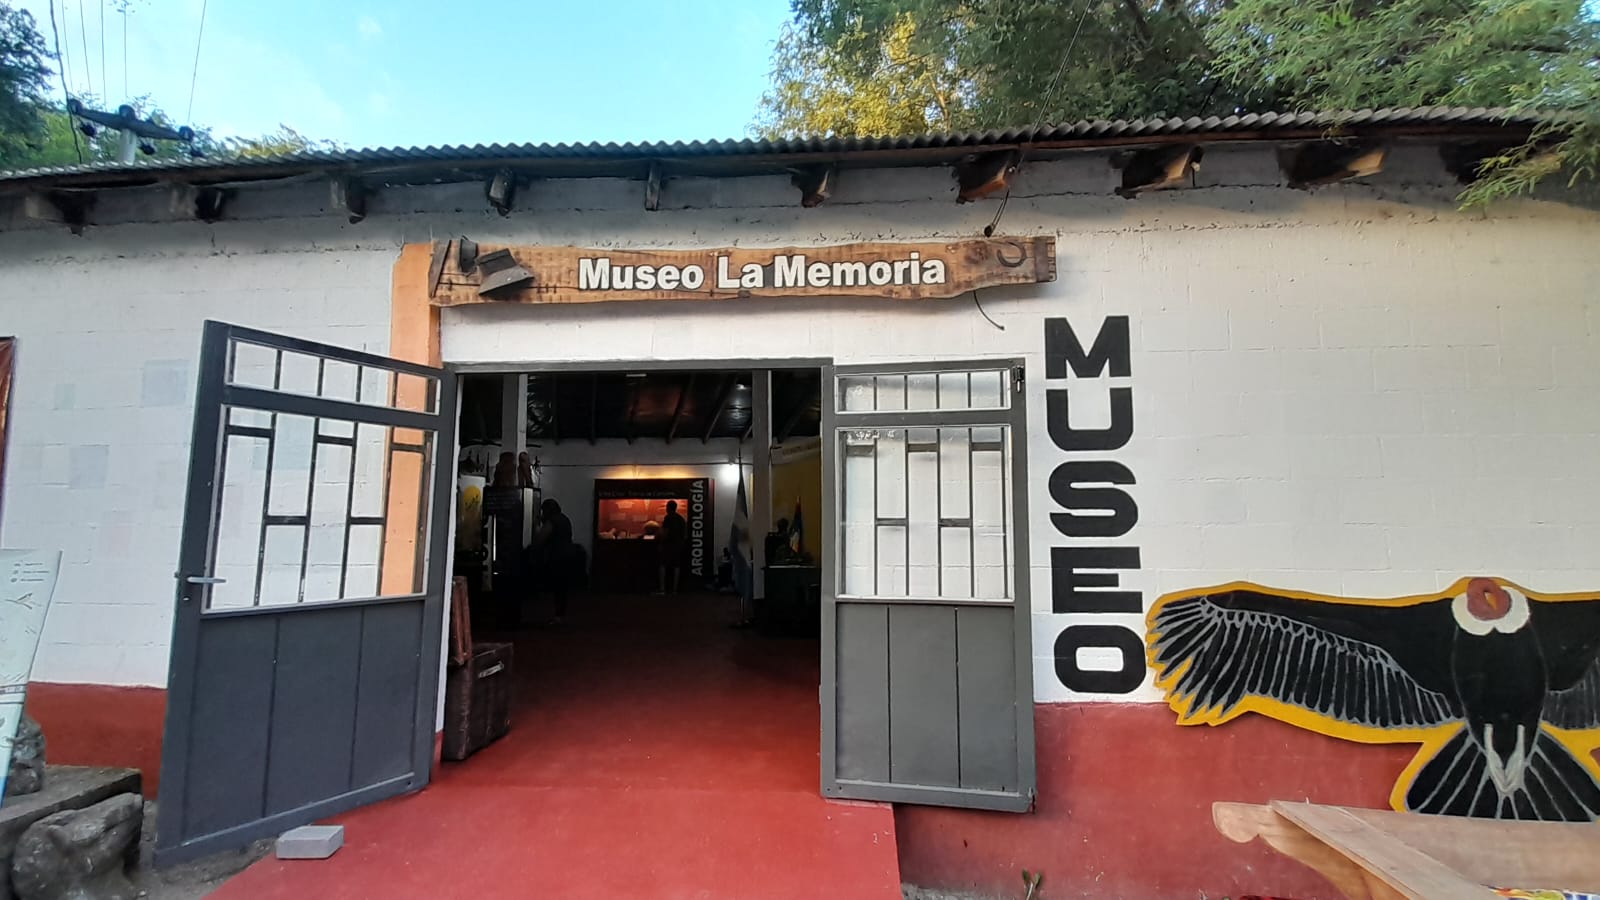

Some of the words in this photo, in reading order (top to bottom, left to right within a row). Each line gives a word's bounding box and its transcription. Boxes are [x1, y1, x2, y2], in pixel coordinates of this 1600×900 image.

[579, 258, 704, 290] Museo
[718, 256, 764, 289] La
[774, 252, 946, 288] Memoria
[690, 480, 704, 576] ARQUEOLOGÍA
[1044, 315, 1147, 694] MUSEO
